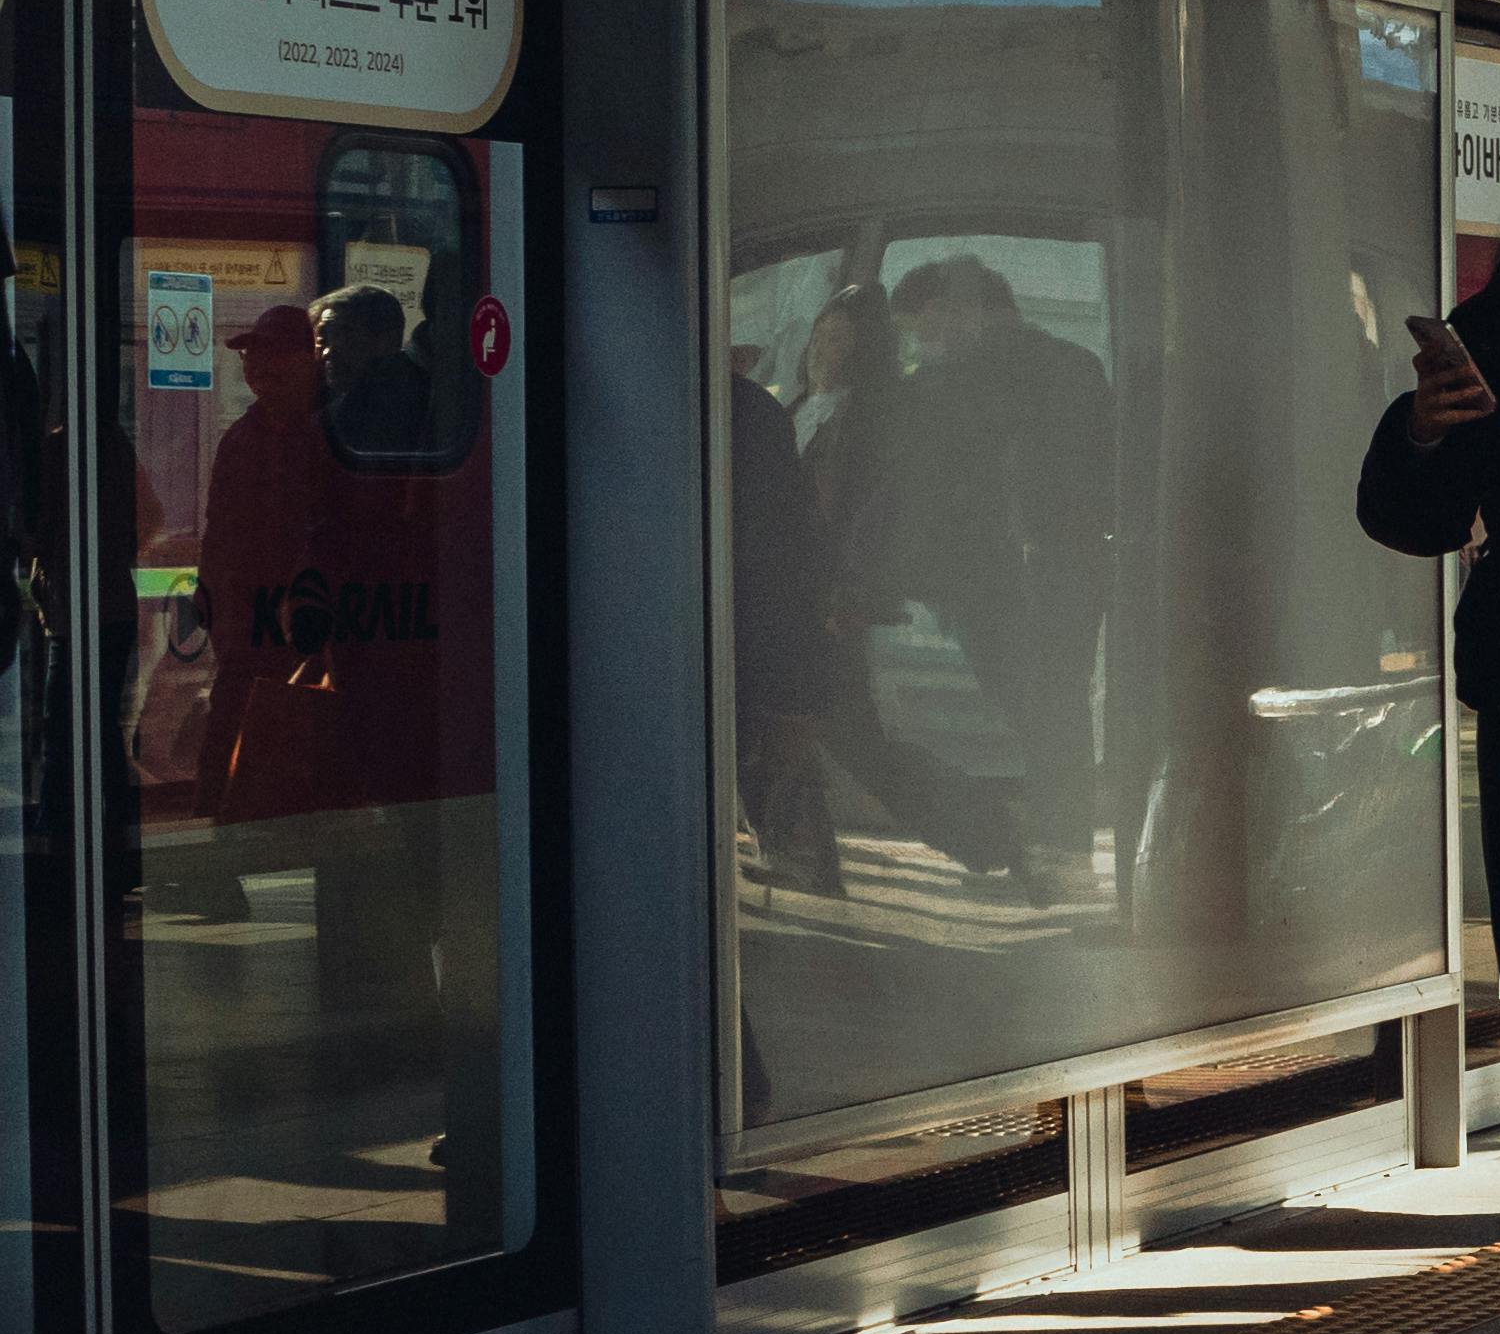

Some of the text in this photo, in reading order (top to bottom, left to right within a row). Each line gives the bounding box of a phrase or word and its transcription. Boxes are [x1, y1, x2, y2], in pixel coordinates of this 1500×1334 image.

[279, 39, 404, 76] (2022, 2023, 2024)
